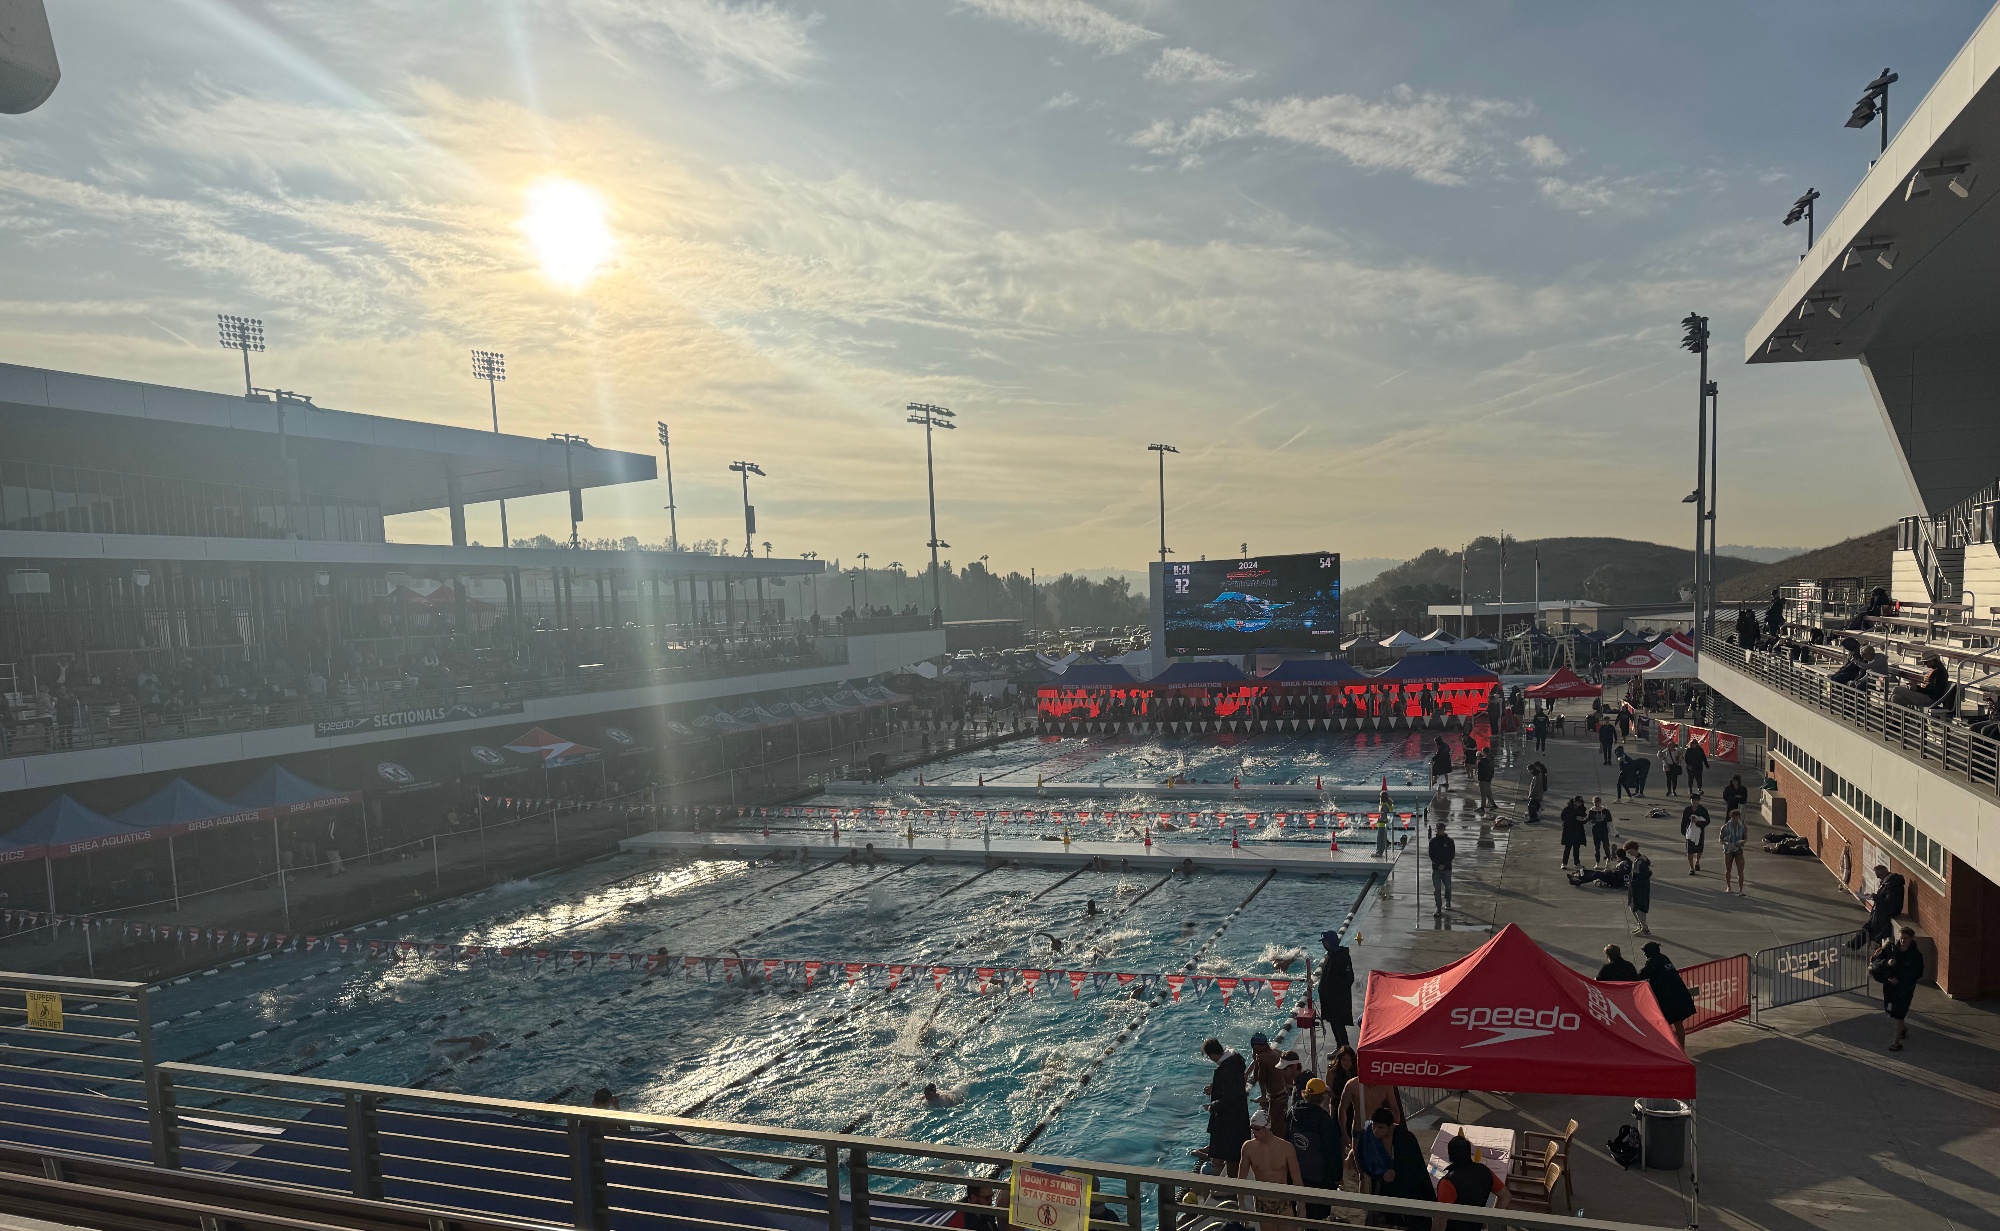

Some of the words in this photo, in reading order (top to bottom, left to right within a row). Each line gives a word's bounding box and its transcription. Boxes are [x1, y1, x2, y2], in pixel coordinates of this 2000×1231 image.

[1238, 562, 1258, 570] 2024
[1174, 579, 1190, 594] 32
[318, 717, 354, 734] speedo
[373, 707, 446, 728] SECTIONALS
[290, 802, 311, 813] BREA
[312, 795, 350, 809] AQUATICS
[188, 819, 214, 831] BREA
[216, 811, 259, 827] AQUATICS
[69, 840, 99, 853] BREA
[101, 830, 152, 847] AQUATICS
[30, 993, 57, 1002] SLIPPERY
[30, 1018, 48, 1027] WHEN
[1450, 1005, 1581, 1031] speedo
[1370, 1060, 1440, 1076] speedo
[1024, 1174, 1049, 1187] DON'T
[1050, 1180, 1077, 1192] STAND
[1023, 1188, 1044, 1200] STAY
[1045, 1194, 1077, 1206] SEATED
